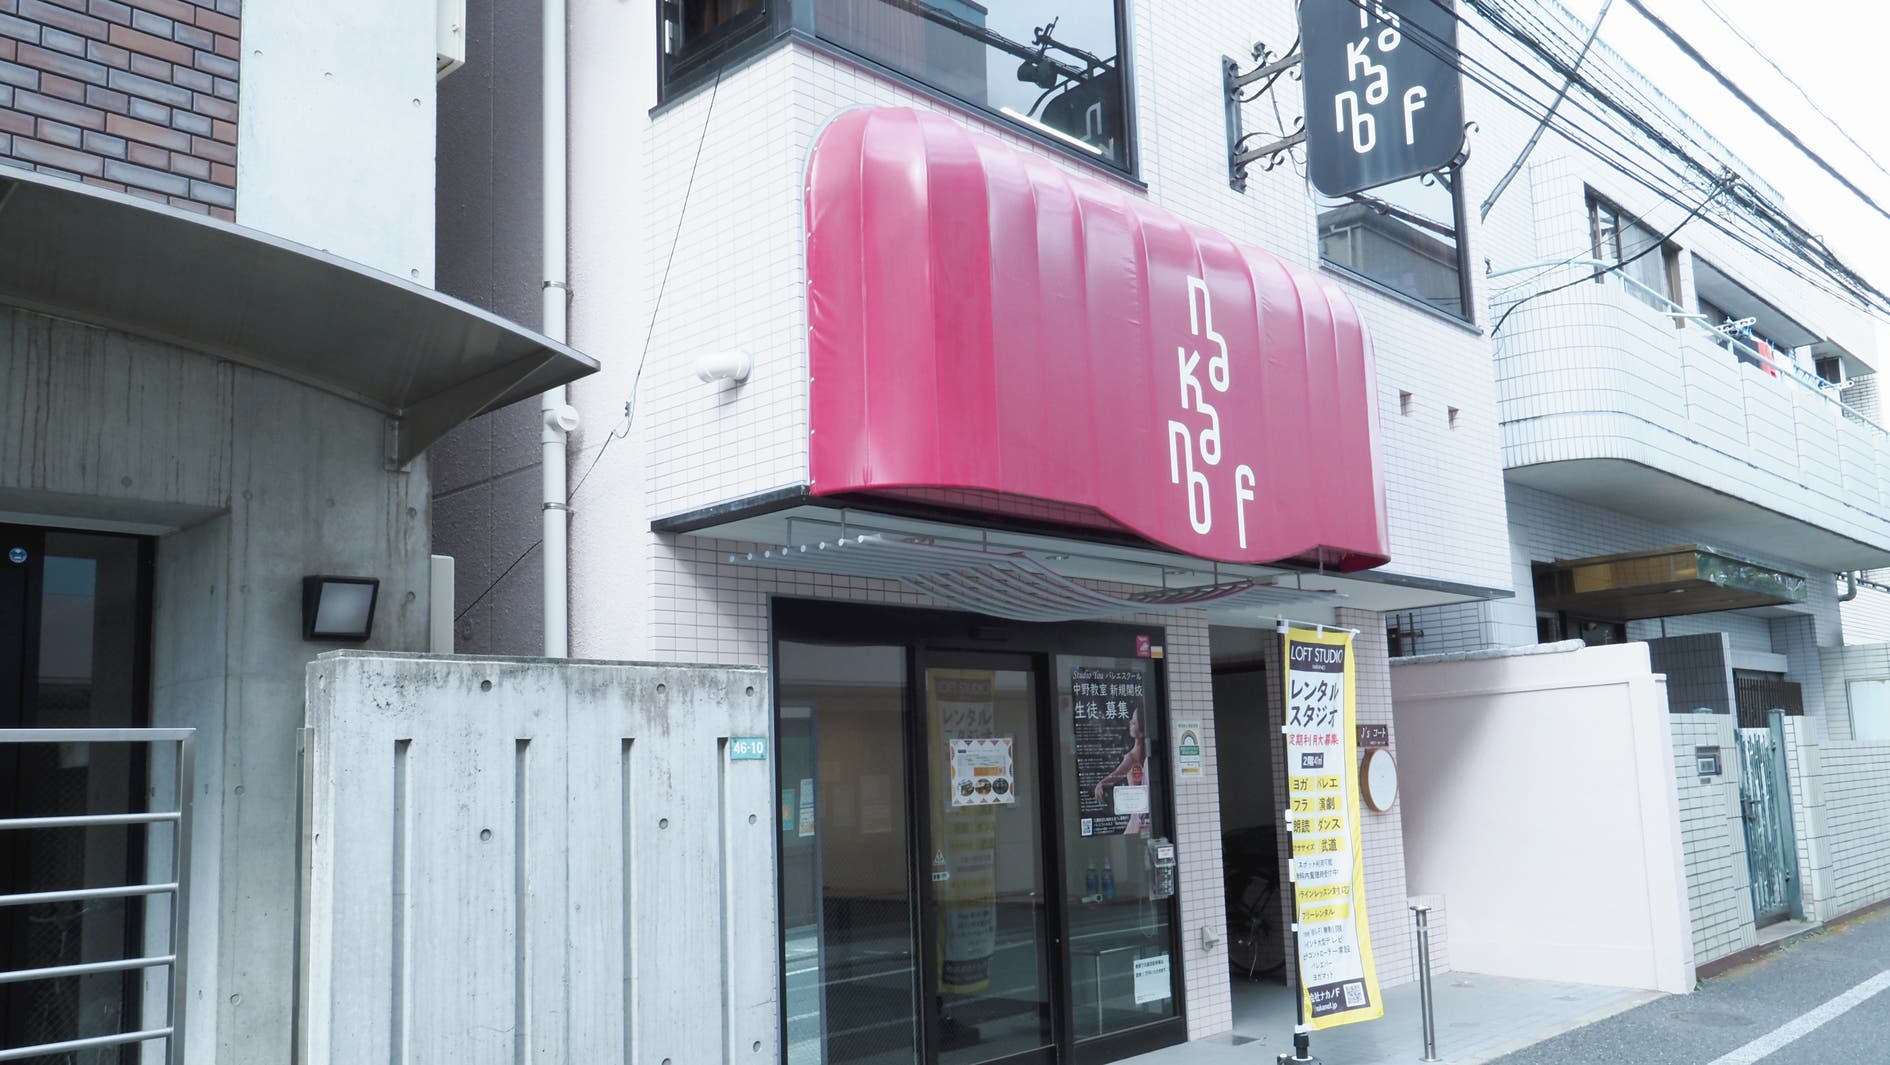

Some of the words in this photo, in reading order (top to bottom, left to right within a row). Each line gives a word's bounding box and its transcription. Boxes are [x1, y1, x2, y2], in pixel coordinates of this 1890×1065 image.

[1290, 645, 1312, 662] LOFT
[1314, 648, 1343, 664] STUDIO
[1073, 682, 1108, 697] 中野教室
[1110, 683, 1144, 697] 新規開校
[1291, 679, 1339, 702] レンタル
[1290, 704, 1338, 728] スタジオ
[1293, 778, 1308, 791] ヨガ
[1293, 798, 1308, 812] フラ
